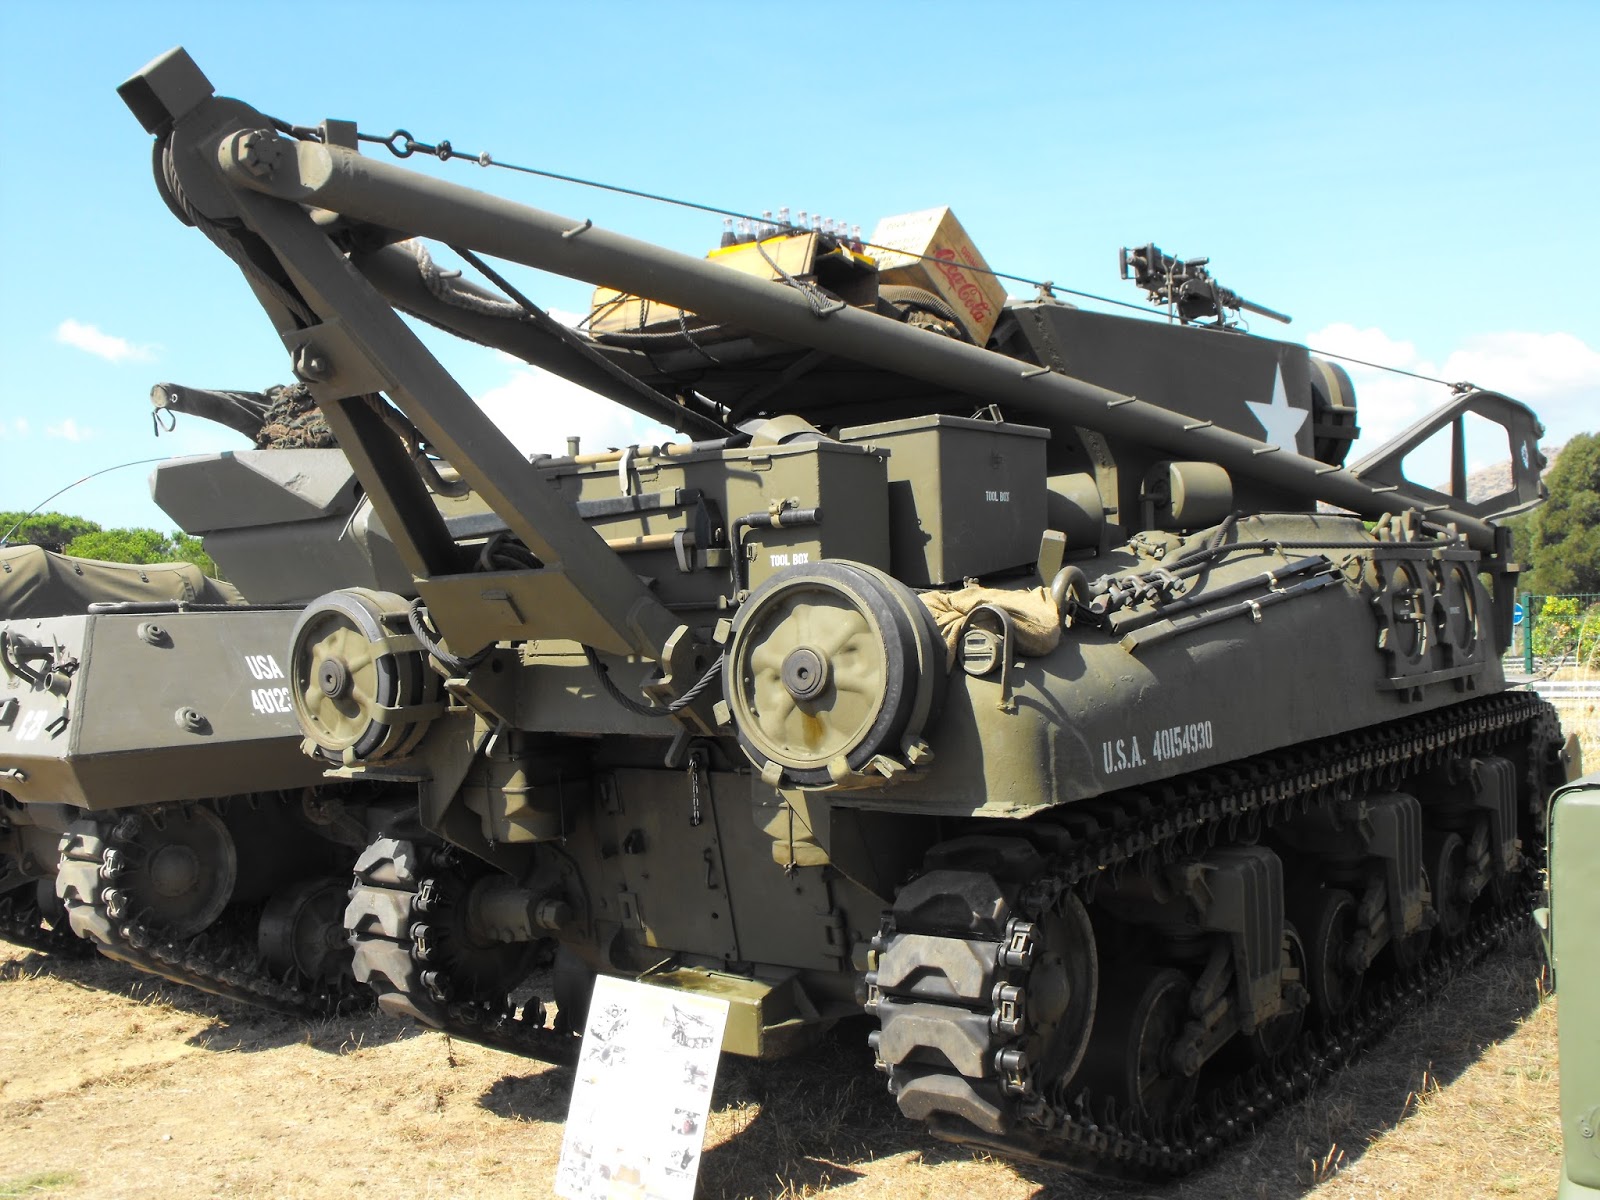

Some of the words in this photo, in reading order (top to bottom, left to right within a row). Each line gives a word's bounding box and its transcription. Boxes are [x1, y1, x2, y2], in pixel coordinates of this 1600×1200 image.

[985, 490, 999, 502] TOOL
[999, 491, 1010, 502] BOX
[770, 553, 790, 567] TOOL
[792, 552, 809, 565] BOX
[244, 654, 285, 680] USA
[1102, 735, 1147, 775] U.S.A.
[1152, 720, 1213, 762] 40154930
